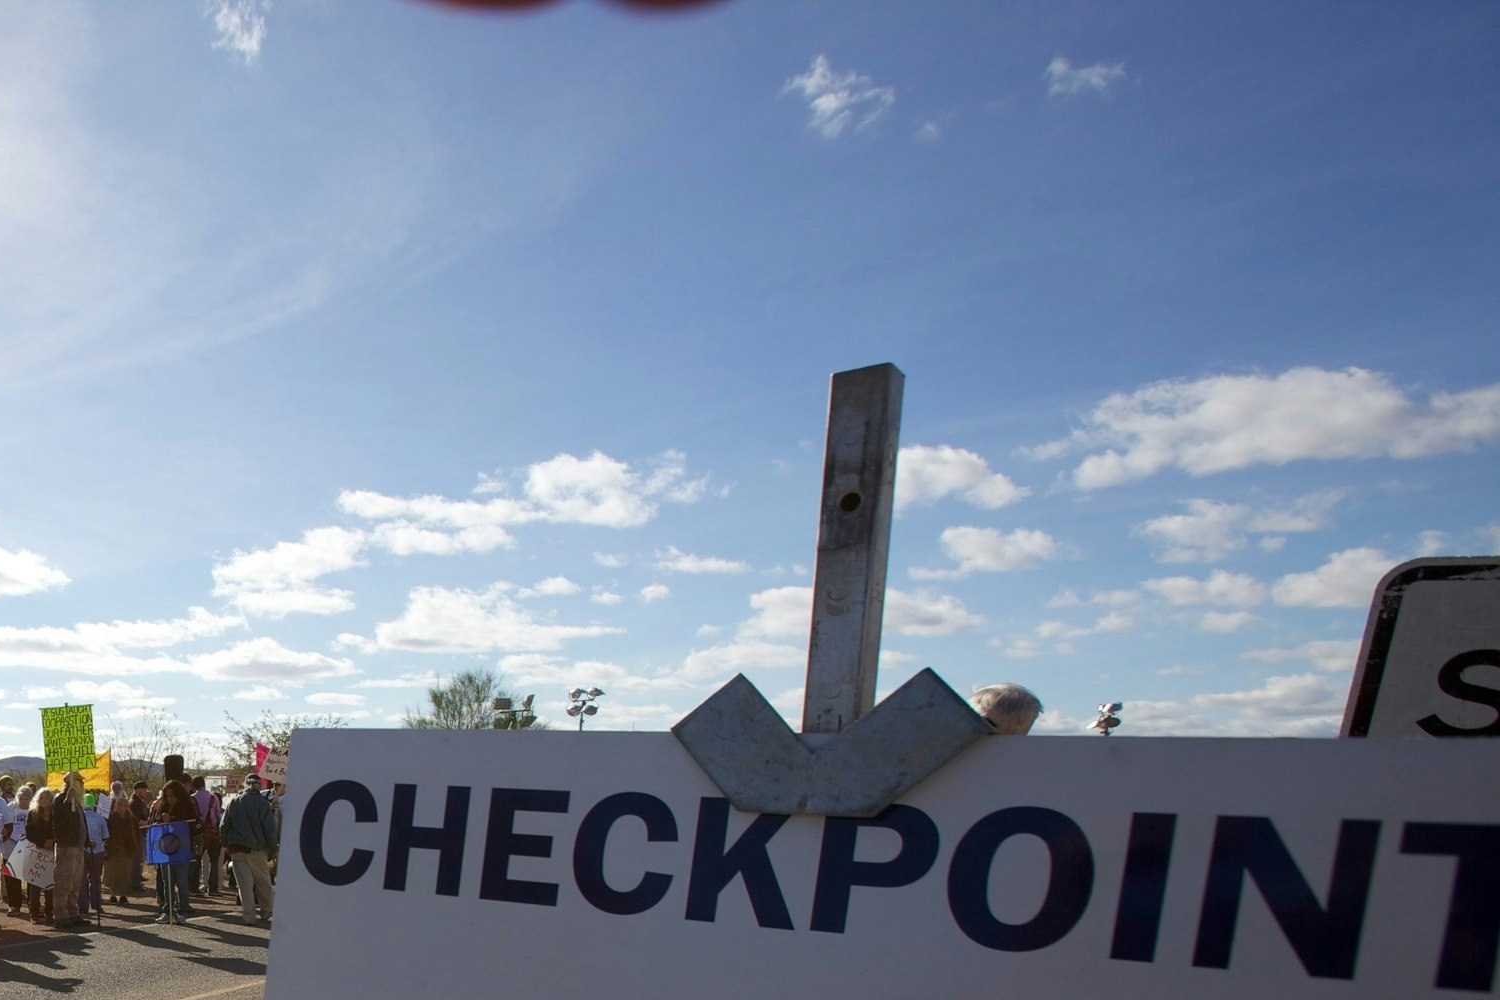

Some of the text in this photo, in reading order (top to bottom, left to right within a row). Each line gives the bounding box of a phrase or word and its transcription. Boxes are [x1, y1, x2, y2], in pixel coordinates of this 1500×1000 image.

[42, 707, 65, 718] JESUS
[60, 724, 94, 737] FATHER
[299, 779, 1500, 993] CHECKPOINT
